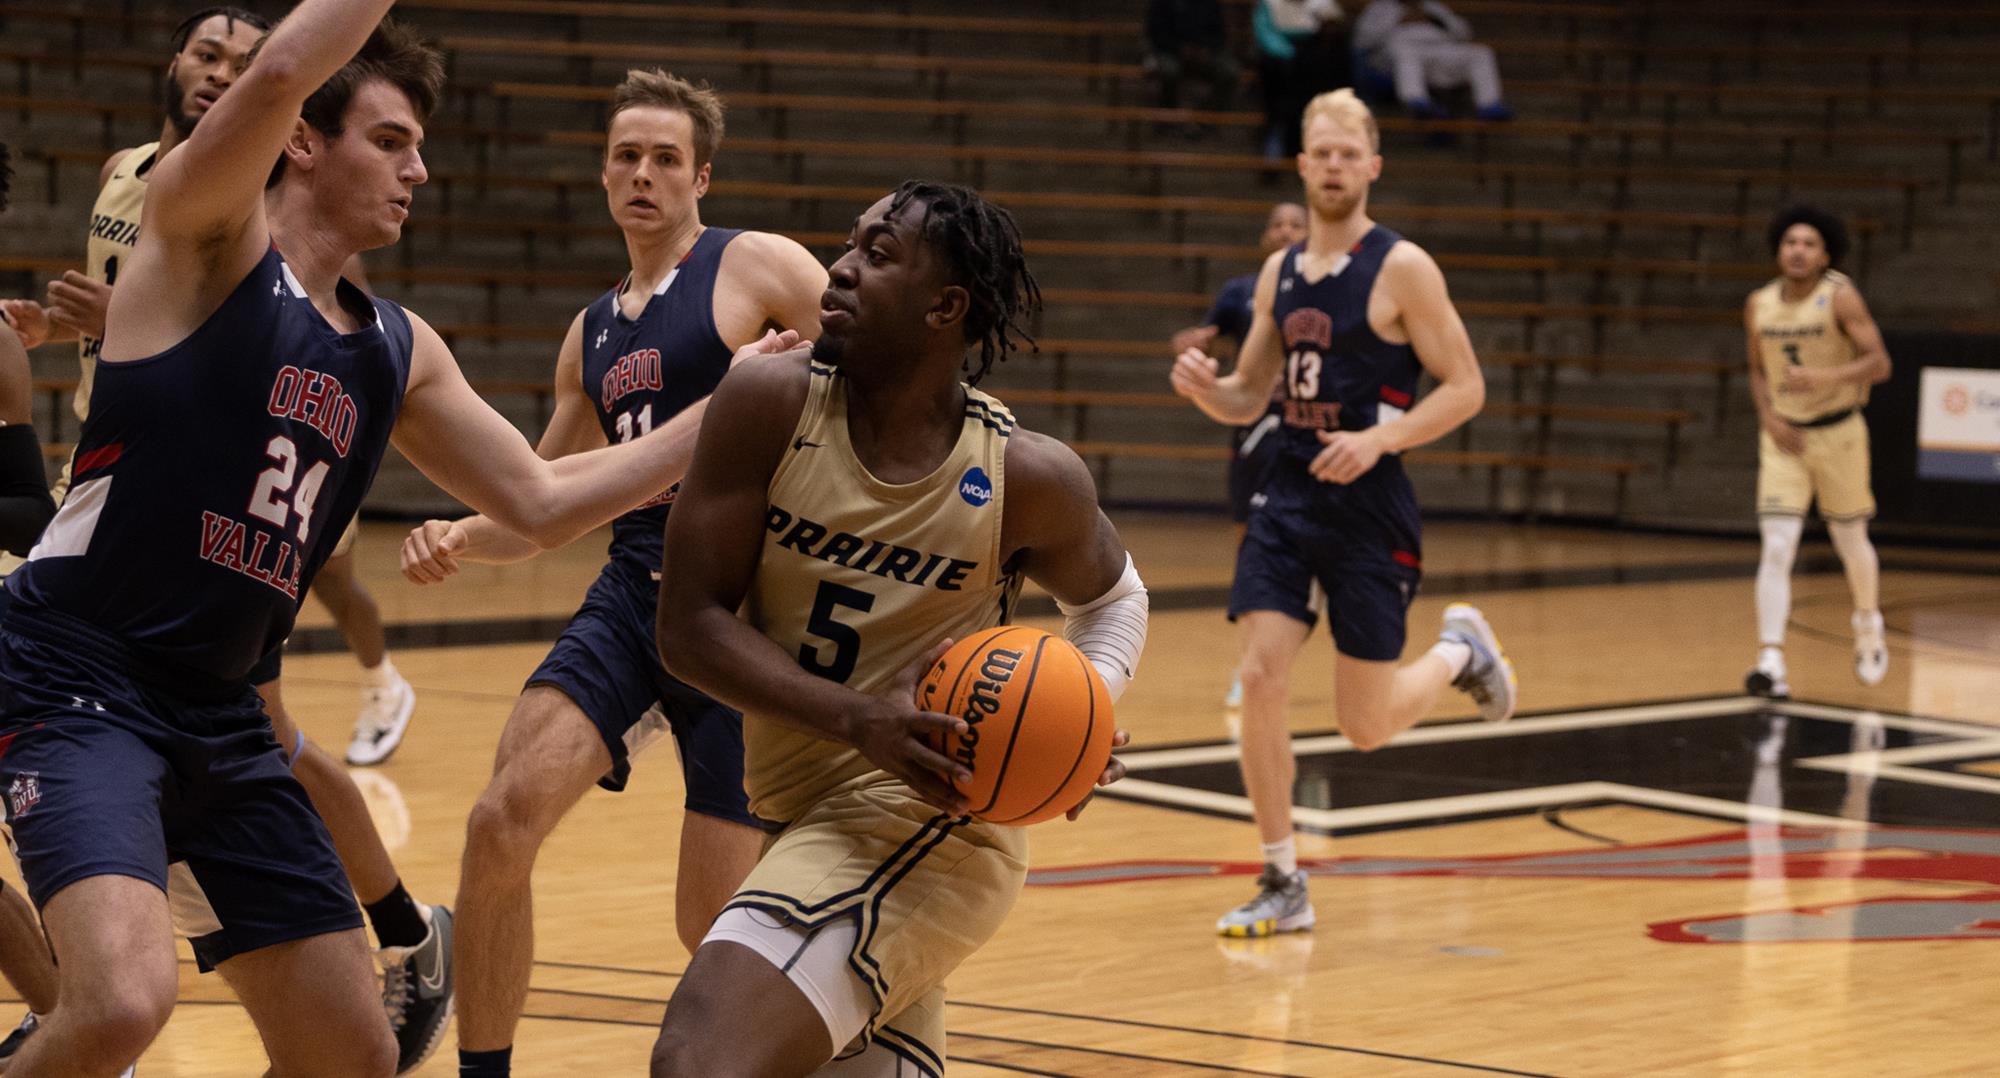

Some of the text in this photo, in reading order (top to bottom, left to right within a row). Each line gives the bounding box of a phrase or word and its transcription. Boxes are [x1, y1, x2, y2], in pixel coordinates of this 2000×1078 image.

[267, 364, 358, 458] OHIO
[602, 348, 663, 413] OHIO
[1288, 350, 1323, 400] 13
[248, 434, 331, 544] 24
[961, 482, 993, 500] NCAA
[767, 504, 979, 591] PRAIRIE
[797, 579, 876, 684] 5
[957, 648, 1025, 772] Wilson
